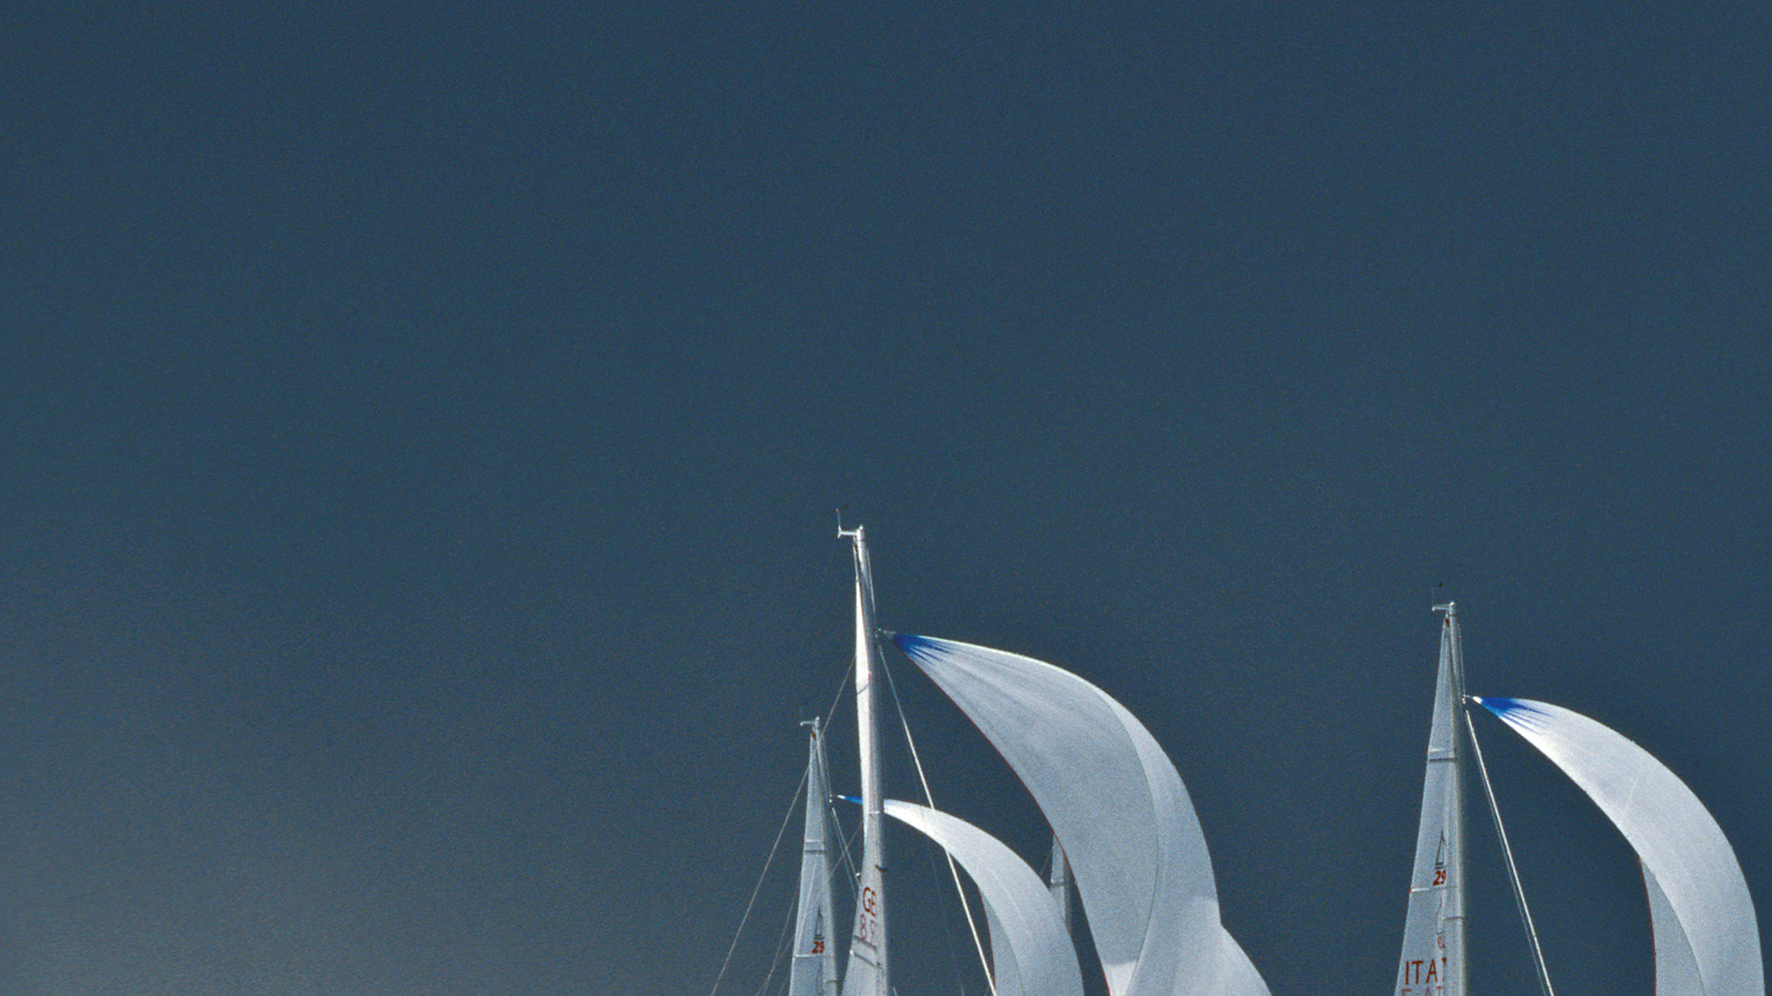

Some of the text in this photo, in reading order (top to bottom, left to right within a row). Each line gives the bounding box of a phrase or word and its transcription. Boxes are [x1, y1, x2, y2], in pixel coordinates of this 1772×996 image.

[1432, 869, 1446, 886] 29
[812, 941, 825, 954] 29
[1405, 959, 1438, 985] ITA
